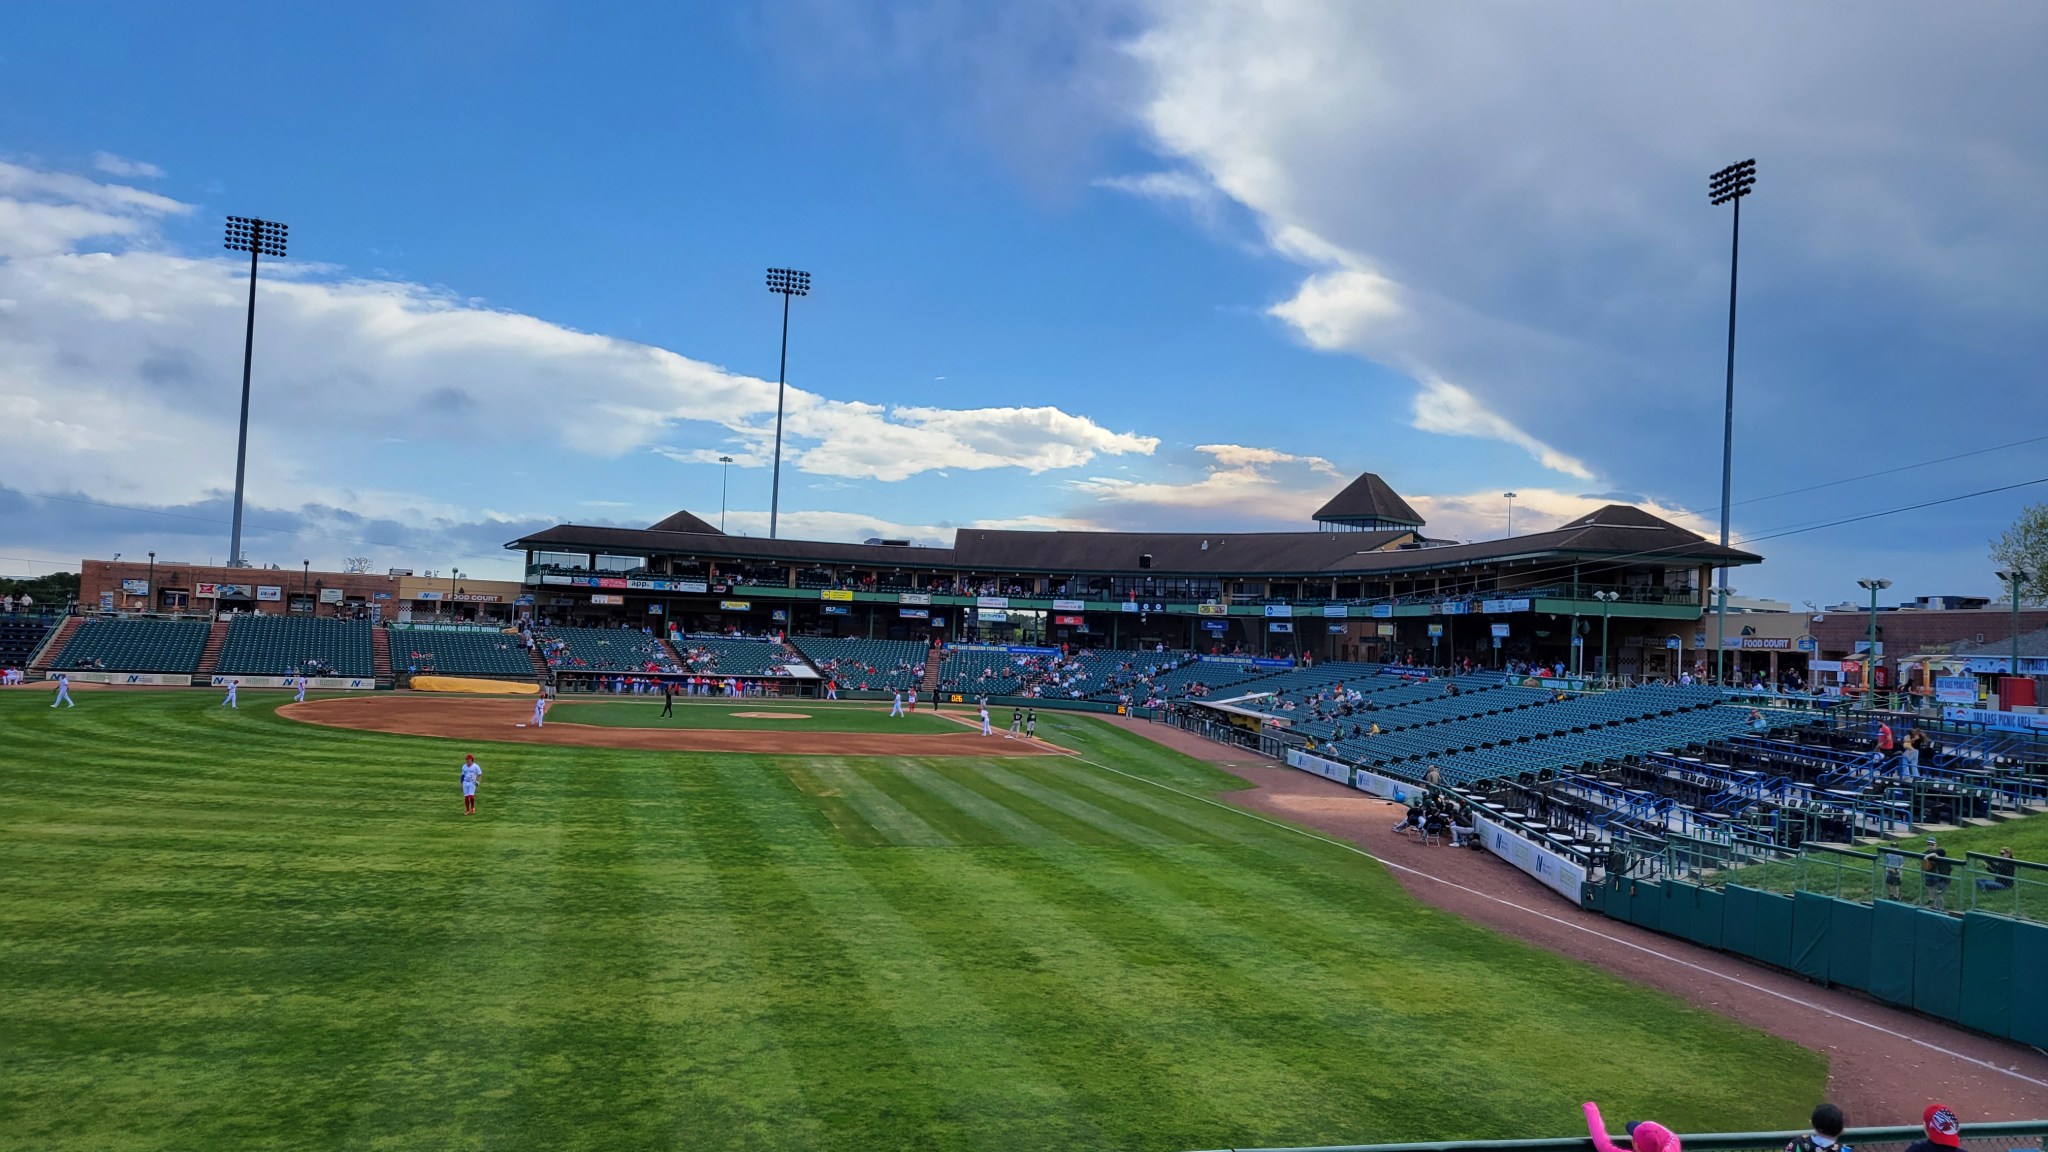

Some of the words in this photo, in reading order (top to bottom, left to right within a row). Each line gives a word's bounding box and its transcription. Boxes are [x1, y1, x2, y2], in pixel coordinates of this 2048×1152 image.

[1743, 639, 1763, 648] FOOD
[1764, 640, 1789, 648] COURT
[1984, 713, 1996, 724] BASE
[1999, 714, 2016, 727] PICNIC
[2017, 716, 2031, 728] AREA
